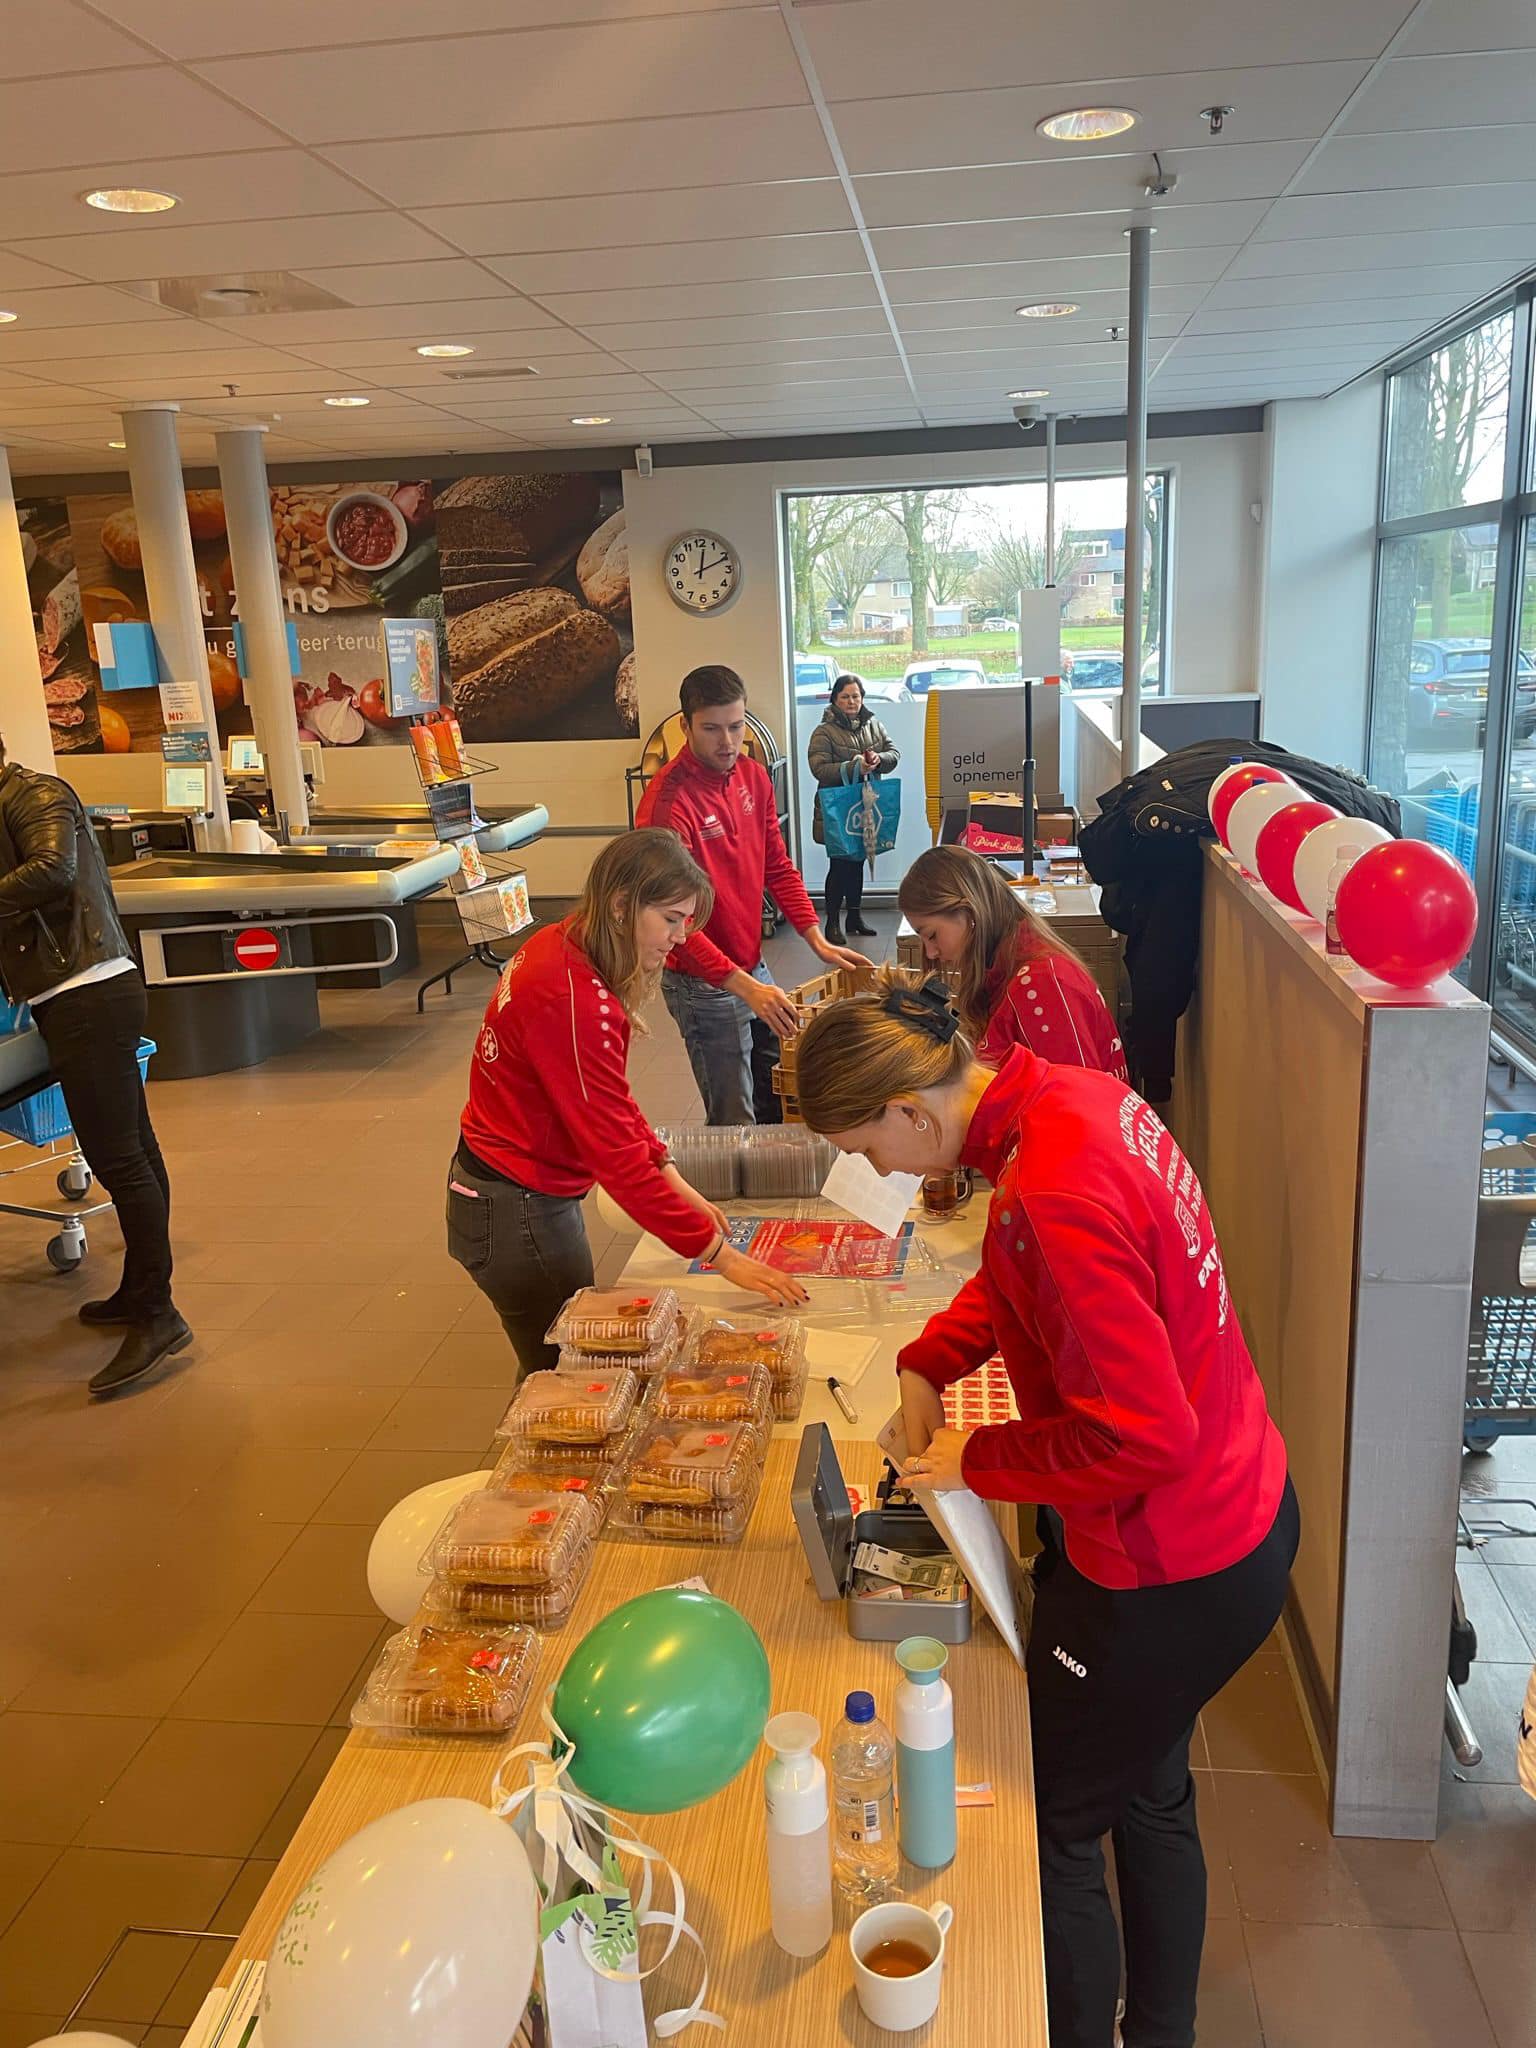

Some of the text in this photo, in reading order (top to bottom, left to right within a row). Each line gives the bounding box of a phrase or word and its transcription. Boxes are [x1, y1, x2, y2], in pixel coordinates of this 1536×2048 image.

[684, 543, 692, 552] 11
[694, 539, 706, 548] 12
[675, 553, 685, 562] 10
[672, 567, 679, 576] 9
[725, 565, 732, 574] 3
[676, 580, 683, 589] 8
[720, 579, 727, 587] 4
[687, 591, 694, 600] 7
[699, 594, 707, 603] 6
[712, 590, 719, 599] 5
[297, 637, 328, 652] eer
[953, 752, 985, 769] geld
[973, 835, 1000, 848] Pink
[901, 1555, 912, 1566] 5
[1052, 1645, 1087, 1678] JAKO
